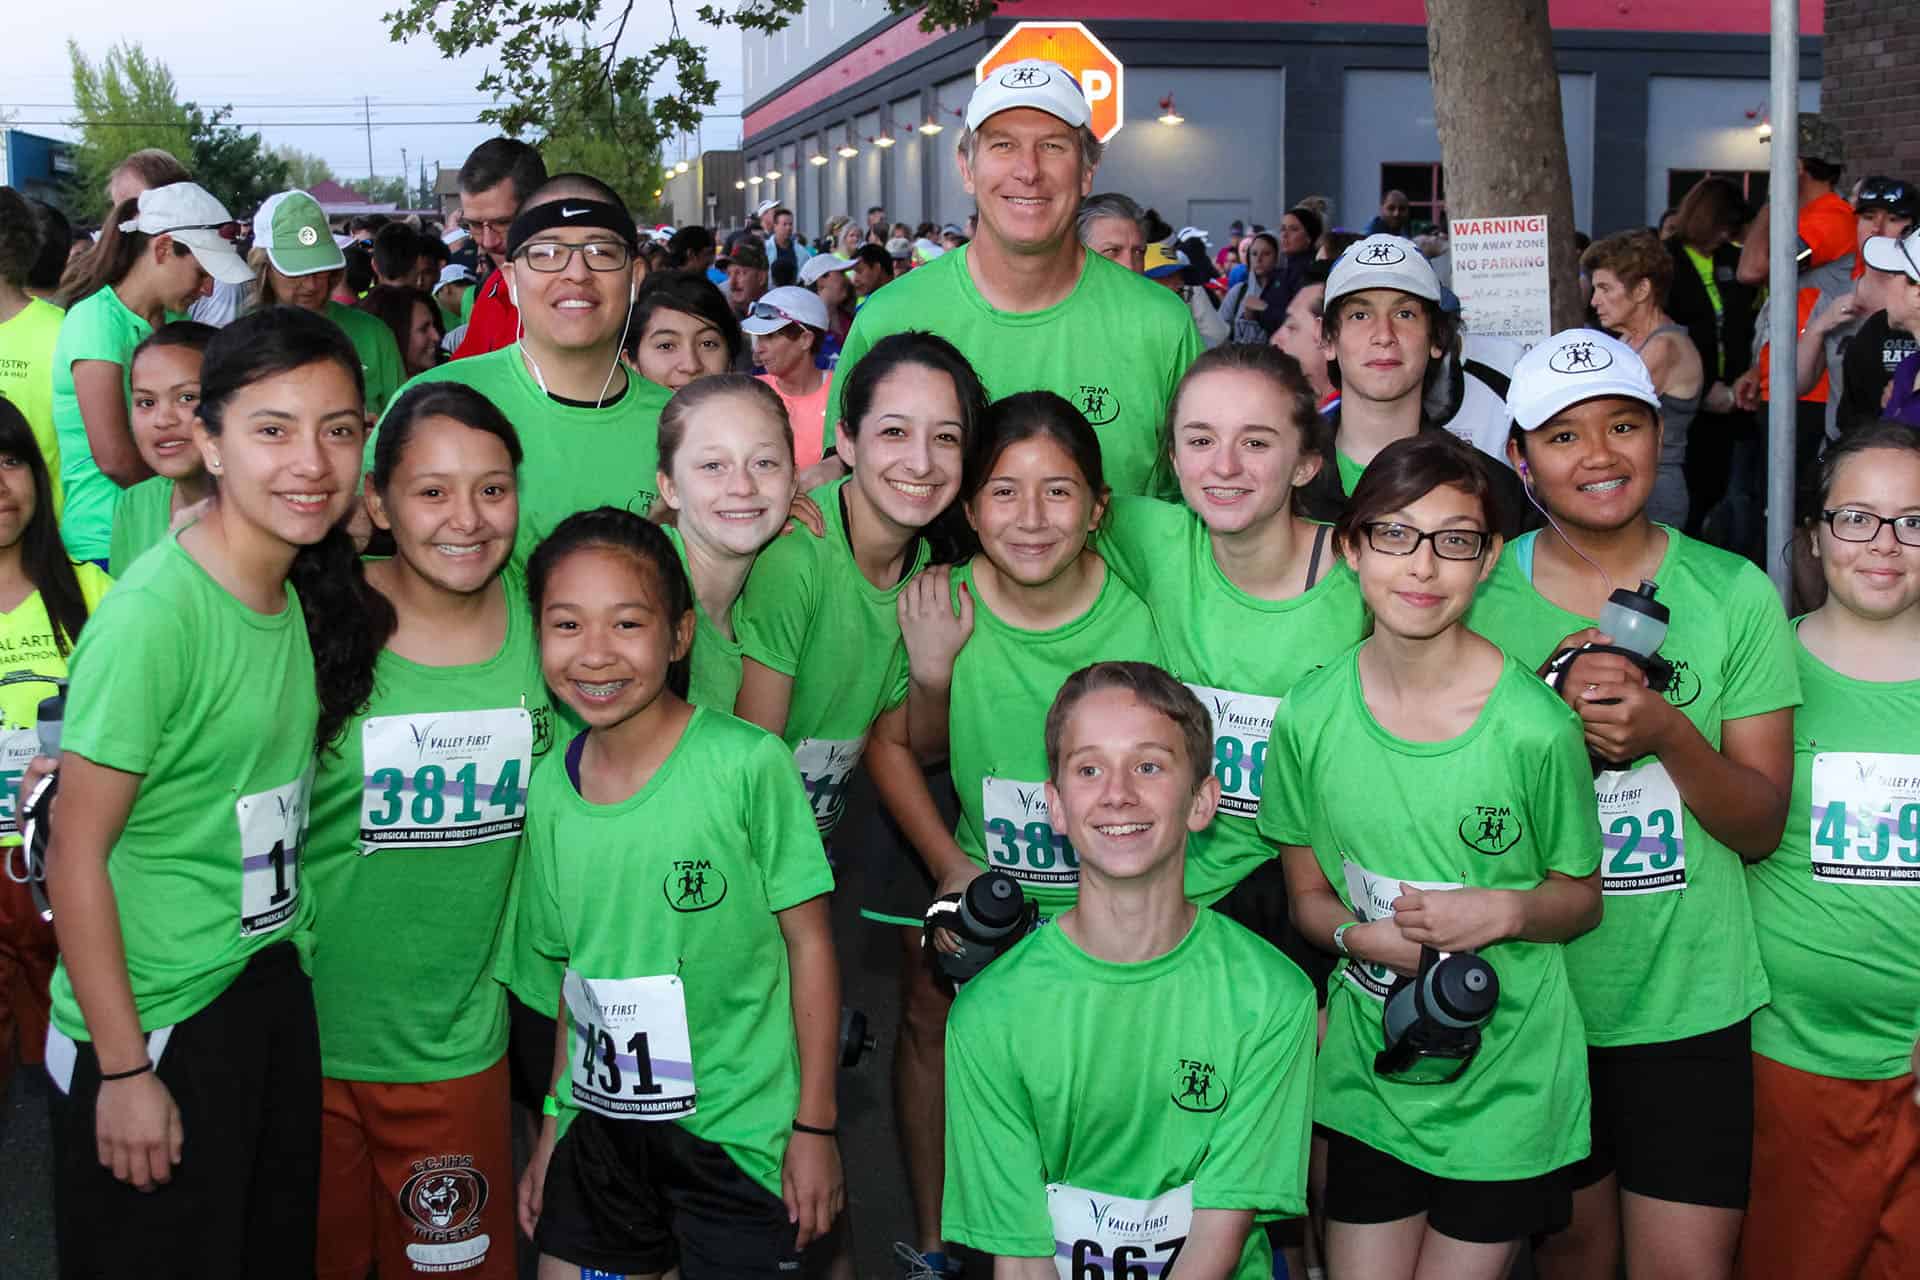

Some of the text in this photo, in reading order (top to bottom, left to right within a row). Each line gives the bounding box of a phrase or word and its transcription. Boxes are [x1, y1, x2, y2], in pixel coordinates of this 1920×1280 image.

[1454, 219, 1545, 235] WARNING!
[1455, 240, 1545, 252] TOW AWAY ZONE
[1456, 256, 1545, 271] NO PARKING
[1079, 385, 1110, 395] TRM
[1228, 712, 1259, 726] VALLEY
[431, 735, 492, 749] VALLEY FIRST
[369, 758, 522, 826] 3814
[1621, 788, 1642, 801] FIRST
[1475, 806, 1510, 816] TRM
[373, 822, 513, 841] SURGICAL ARTISTRY MODESTO MARATHON
[1608, 809, 1678, 874] 23
[673, 859, 713, 871] TRM
[1822, 866, 1855, 876] SURGICAL
[1856, 867, 1889, 878] ARTISTRY
[1030, 873, 1058, 881] ARTISTRY
[1603, 873, 1675, 889] MODESTO MARATHON
[611, 1004, 637, 1016] FIRST
[583, 1022, 663, 1096] 431
[1179, 1059, 1216, 1076] TRM
[611, 1101, 641, 1112] MODESTO
[641, 1100, 684, 1112] MARATHON
[413, 1216, 481, 1241] TIGERS
[1108, 1215, 1169, 1233] VALLEY FIRST
[1071, 1236, 1187, 1280] 667
